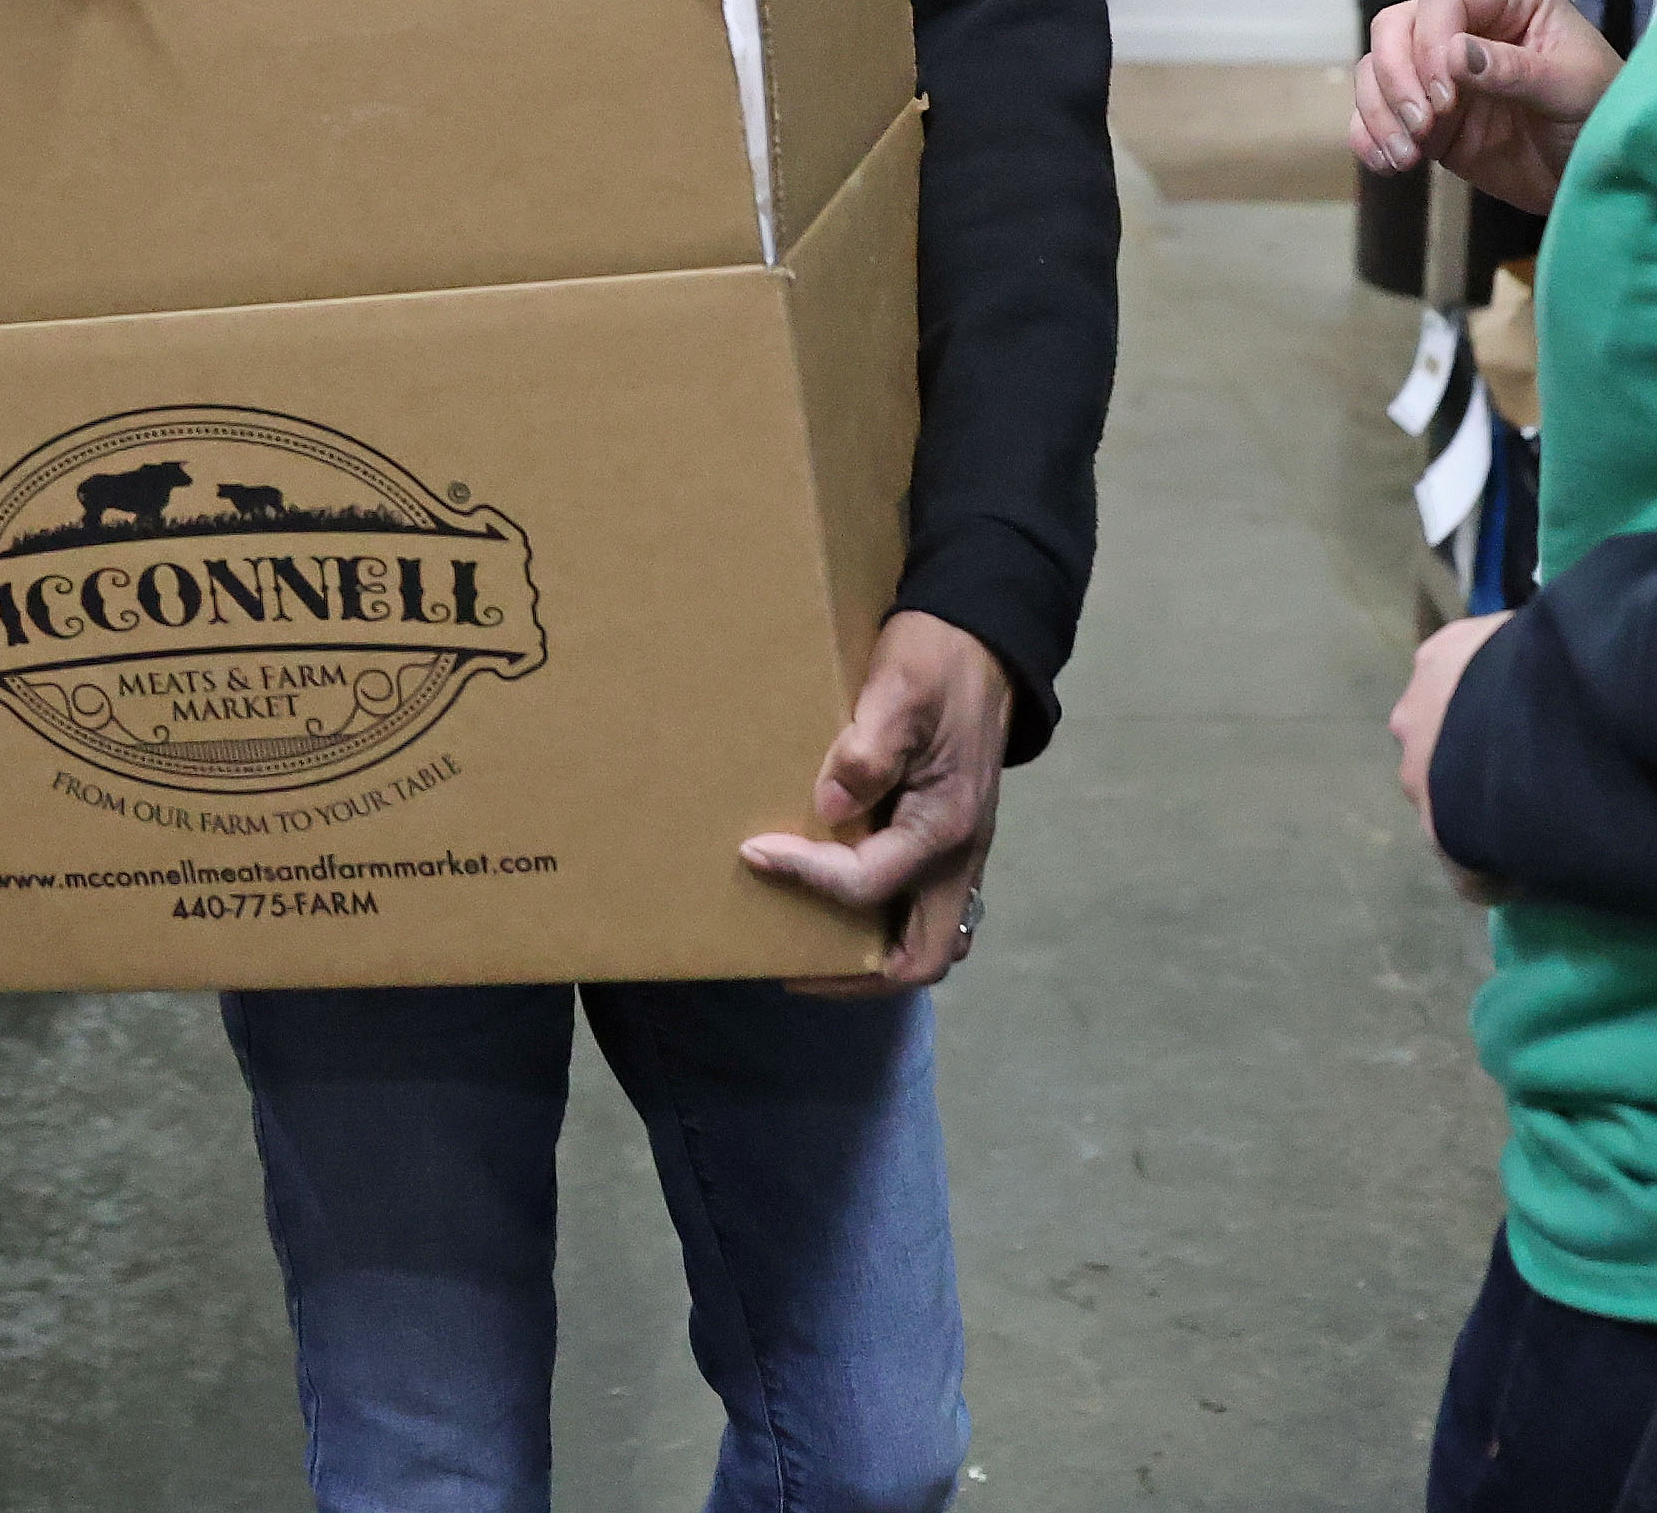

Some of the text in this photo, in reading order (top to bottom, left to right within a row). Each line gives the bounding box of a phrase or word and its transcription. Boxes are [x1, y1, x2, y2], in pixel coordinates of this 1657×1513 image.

[118, 663, 349, 697] MEATS & FARM
[172, 693, 300, 722] MARKET
[51, 753, 464, 836] FROM OUR FARM TO YOUR TABLE
[171, 891, 380, 921] 440-775-FARM
